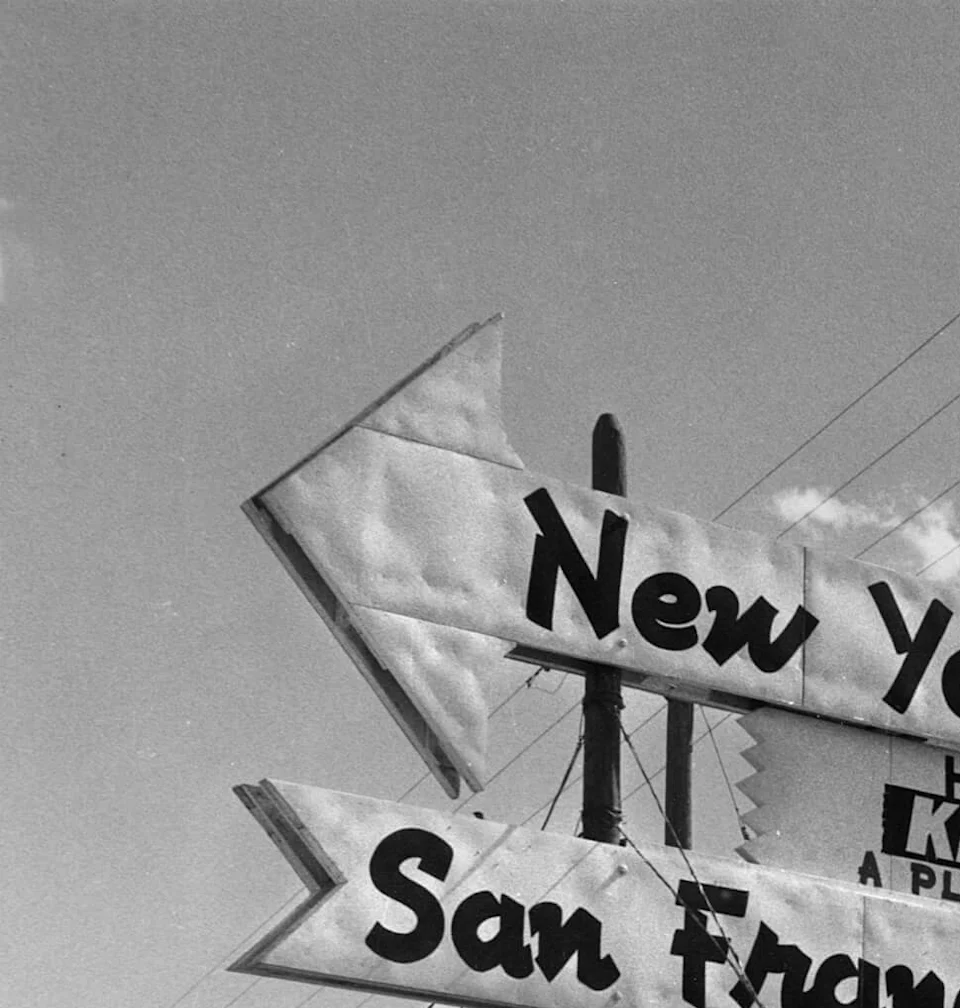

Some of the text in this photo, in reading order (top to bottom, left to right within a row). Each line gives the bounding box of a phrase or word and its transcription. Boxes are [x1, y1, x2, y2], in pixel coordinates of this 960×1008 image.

[523, 487, 820, 673] New
[364, 828, 621, 992] San
[858, 851, 883, 888] A
